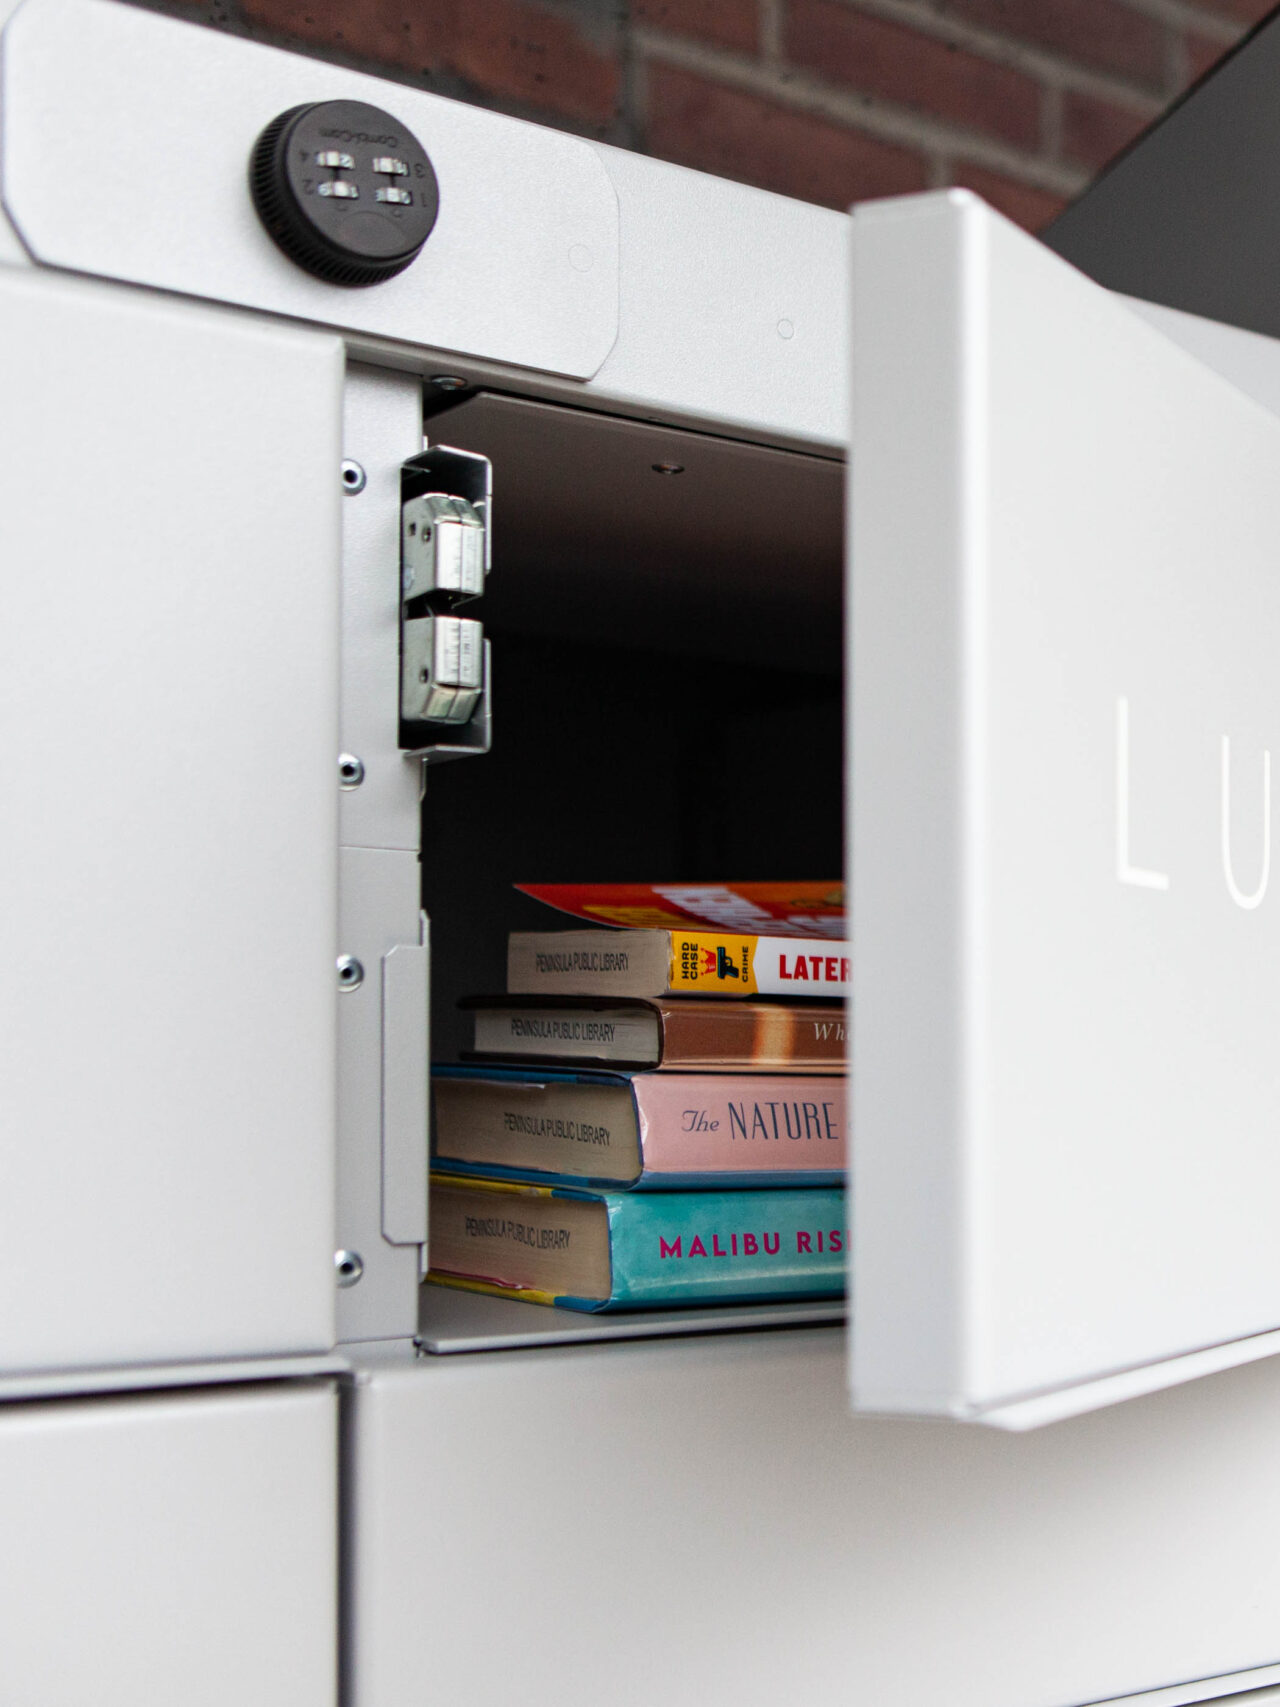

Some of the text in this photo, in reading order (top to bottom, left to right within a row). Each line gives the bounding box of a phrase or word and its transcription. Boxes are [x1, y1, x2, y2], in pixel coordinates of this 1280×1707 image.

[414, 163, 425, 179] 3
[302, 178, 314, 195] 2
[536, 952, 630, 972] PENINSULA PUBLIC LIBRARY
[681, 942, 690, 979] HARD
[690, 943, 698, 981] CASE
[511, 1018, 616, 1043] PENINSULA PUBLIC LIBRARY
[813, 1022, 850, 1041] Wh
[504, 1112, 611, 1147] PENINSULA PUBLIC LIBRARY
[682, 1102, 839, 1141] The NATURE
[465, 1215, 571, 1249] PENINSULA PUBLIC LIBRARY
[659, 1232, 781, 1259] MALIBU
